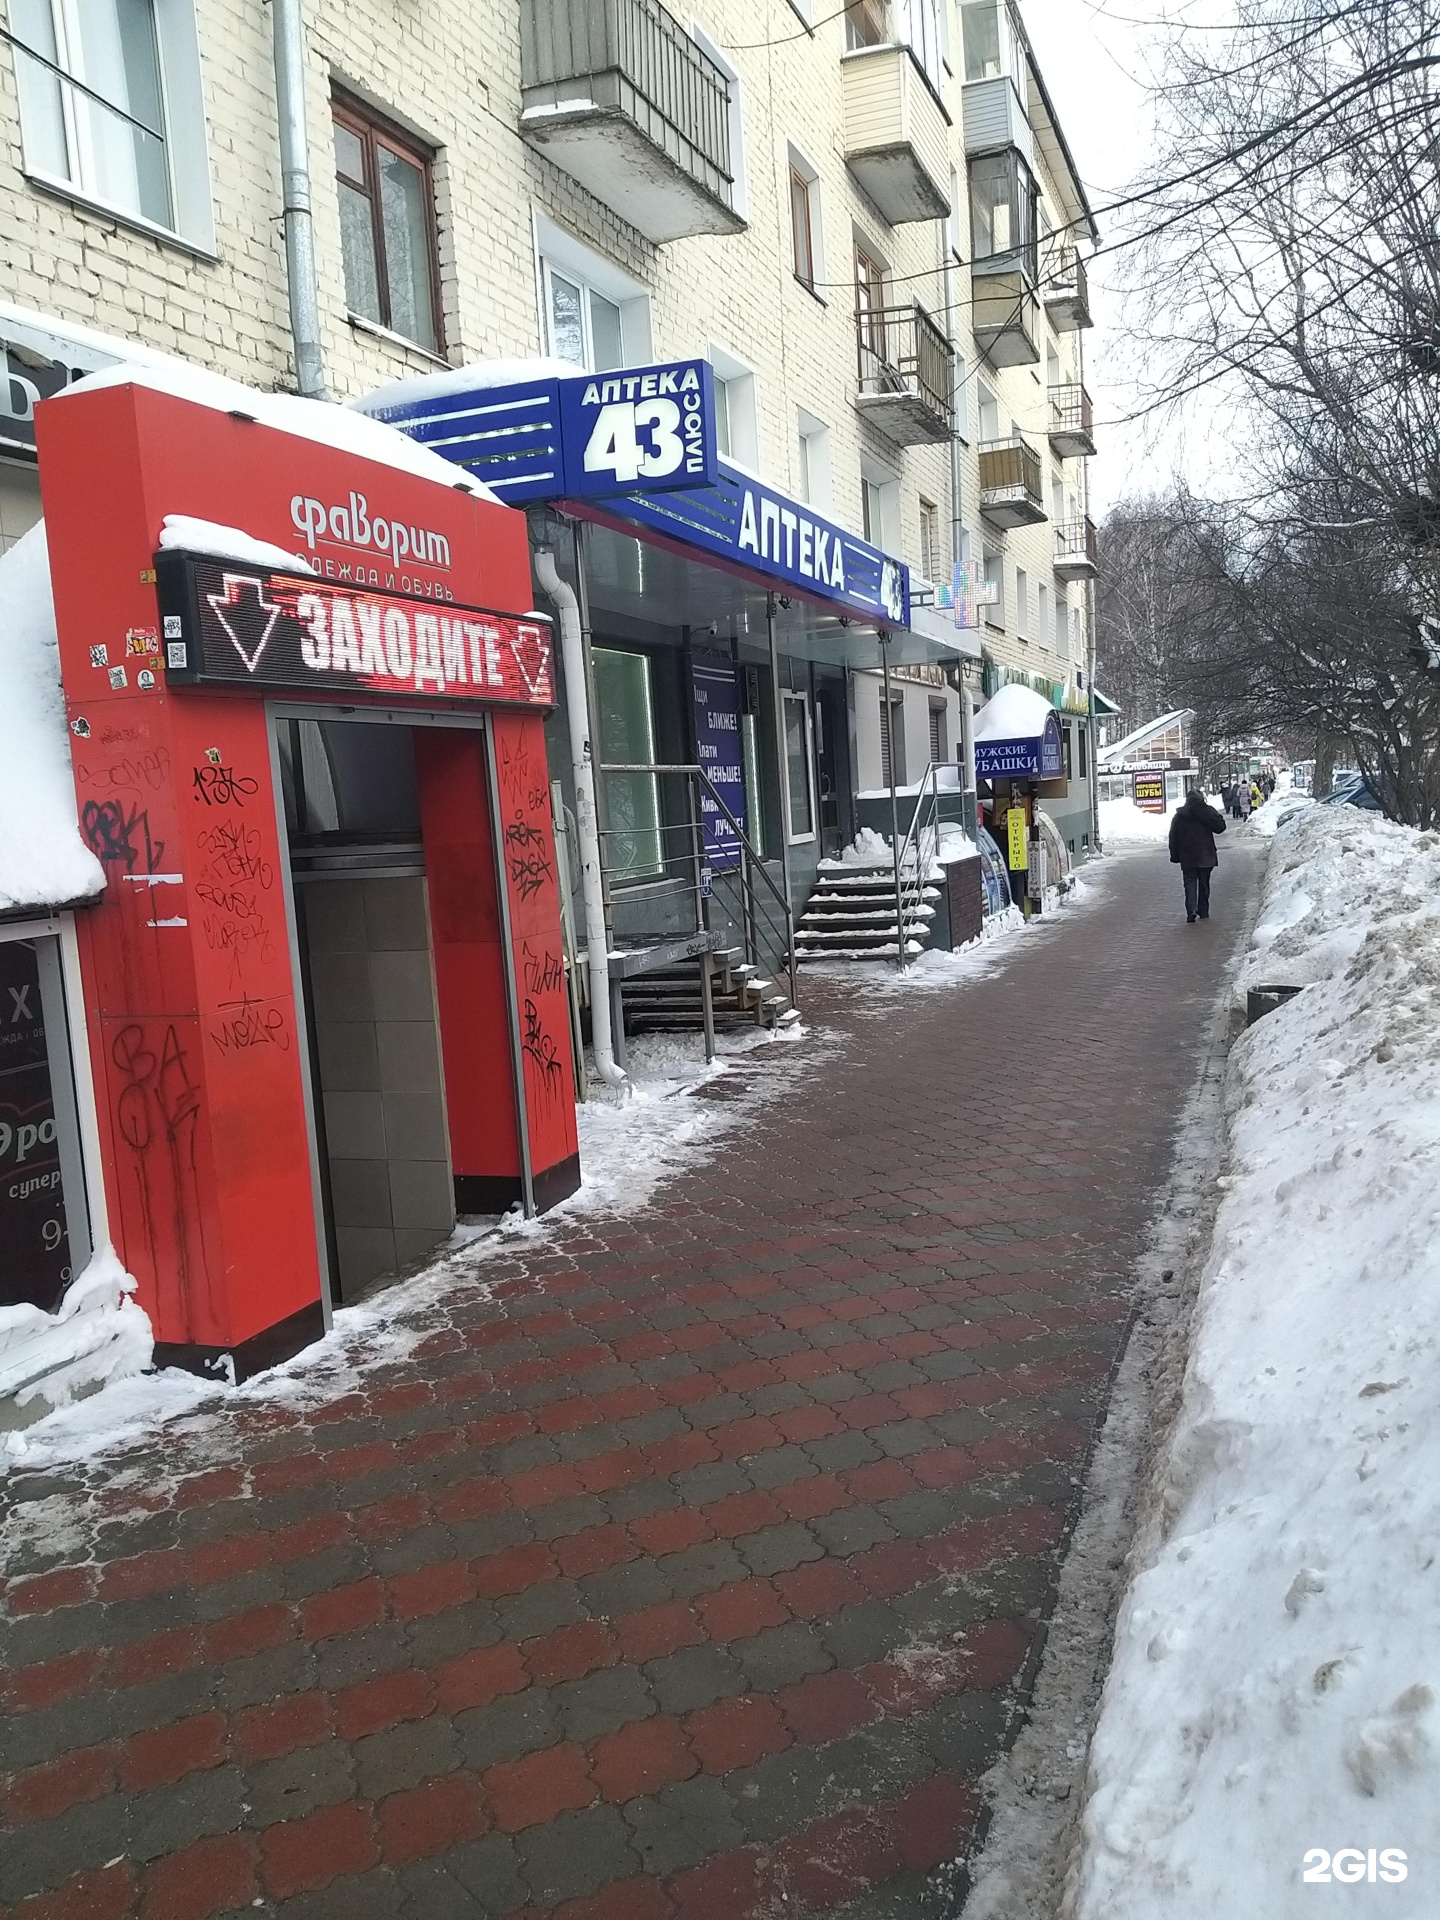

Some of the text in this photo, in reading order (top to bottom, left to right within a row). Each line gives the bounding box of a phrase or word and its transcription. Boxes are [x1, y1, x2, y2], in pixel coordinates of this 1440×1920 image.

[581, 368, 699, 406] АПТЕКА
[583, 398, 684, 482] 43
[683, 393, 703, 473] ПЛЮС
[738, 489, 845, 591] АПТЕКА
[385, 572, 395, 589] И
[401, 575, 453, 600] ОБУВЬ
[297, 593, 504, 691] ЗАХОДИТЕ
[708, 712, 737, 730] БЛИЖЕ!
[707, 765, 741, 783] МЕНЬШЕ!
[974, 756, 1038, 772] УБАШКИ
[1136, 788, 1162, 798] ШУБЫ
[1012, 822, 1021, 869] ОТКРЫТО
